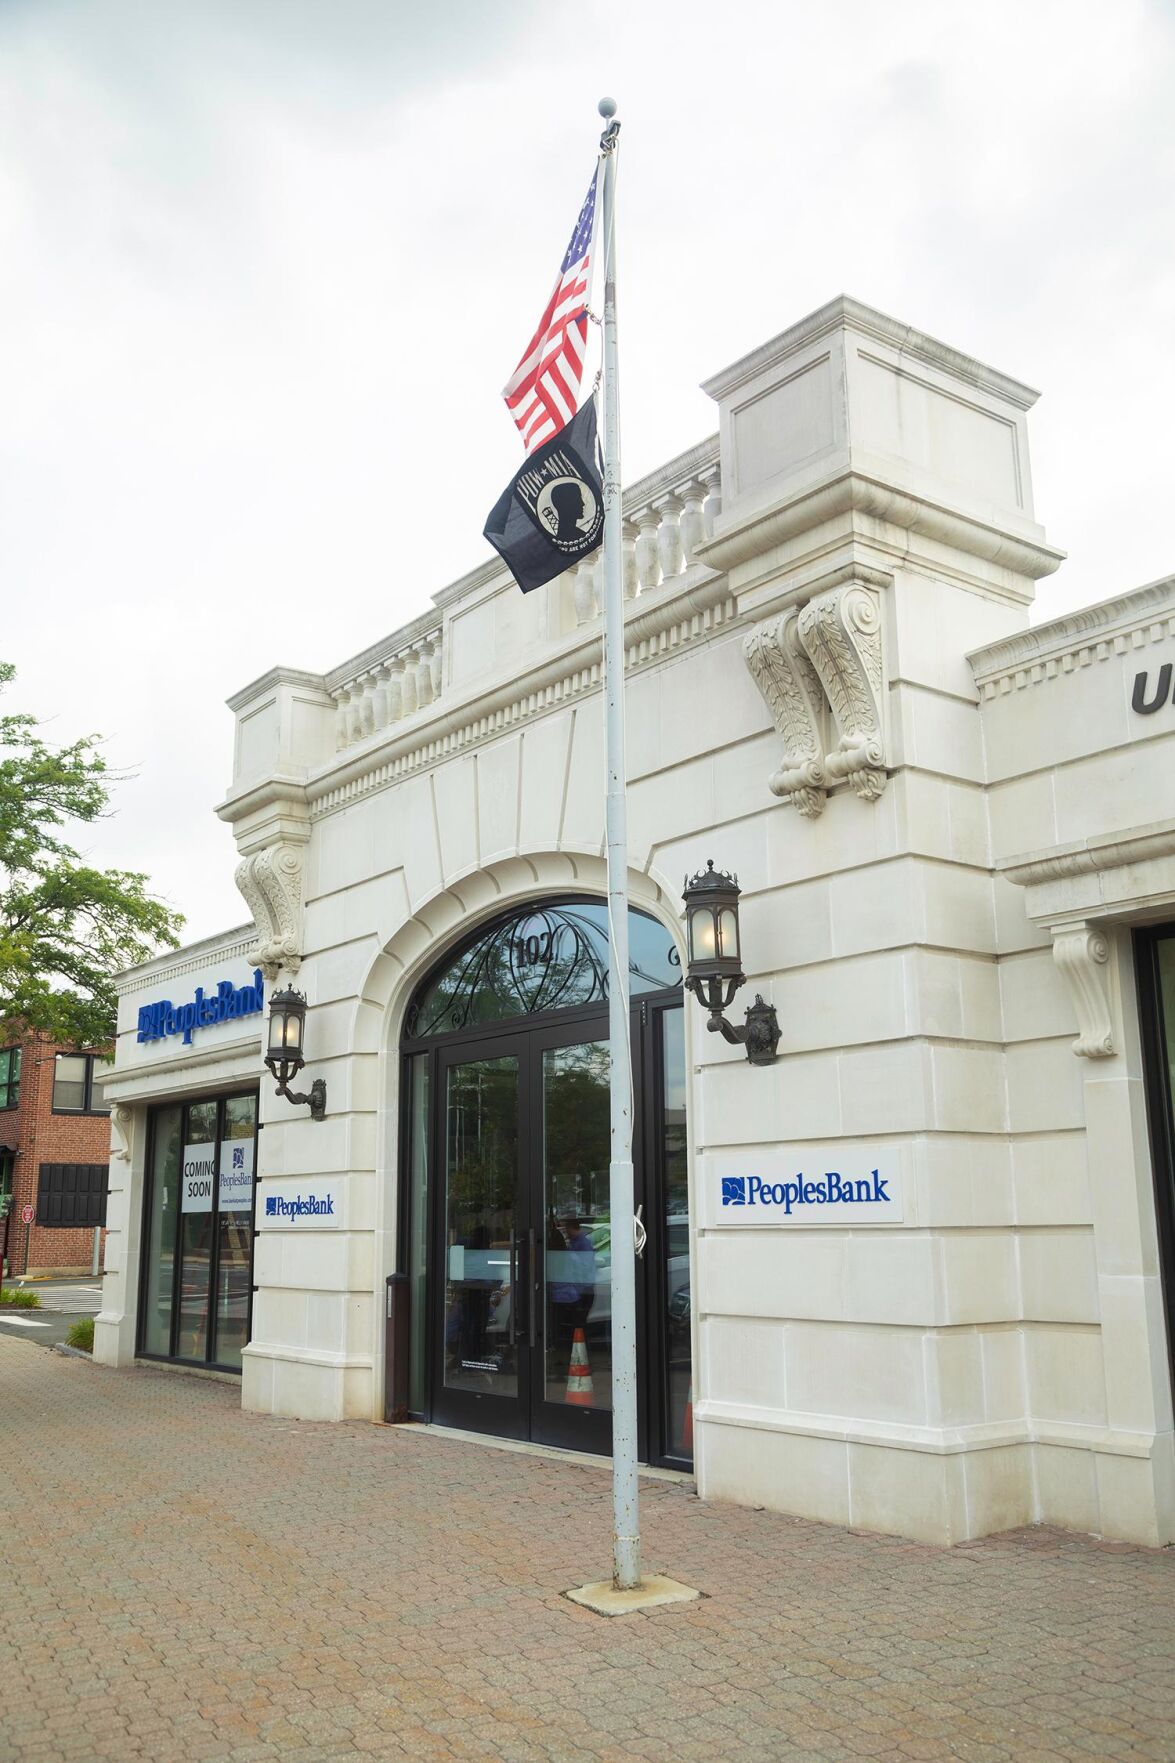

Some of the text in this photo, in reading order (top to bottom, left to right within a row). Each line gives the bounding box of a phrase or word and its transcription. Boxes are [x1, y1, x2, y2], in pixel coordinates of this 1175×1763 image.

[516, 449, 582, 515] POW MIA
[1131, 662, 1175, 715] U
[515, 931, 554, 968] 102
[156, 968, 264, 1045] PeoplesBank
[187, 1181, 211, 1198] SOON
[276, 1193, 334, 1222] PeoplesBank
[746, 1169, 891, 1215] PeoplesBank
